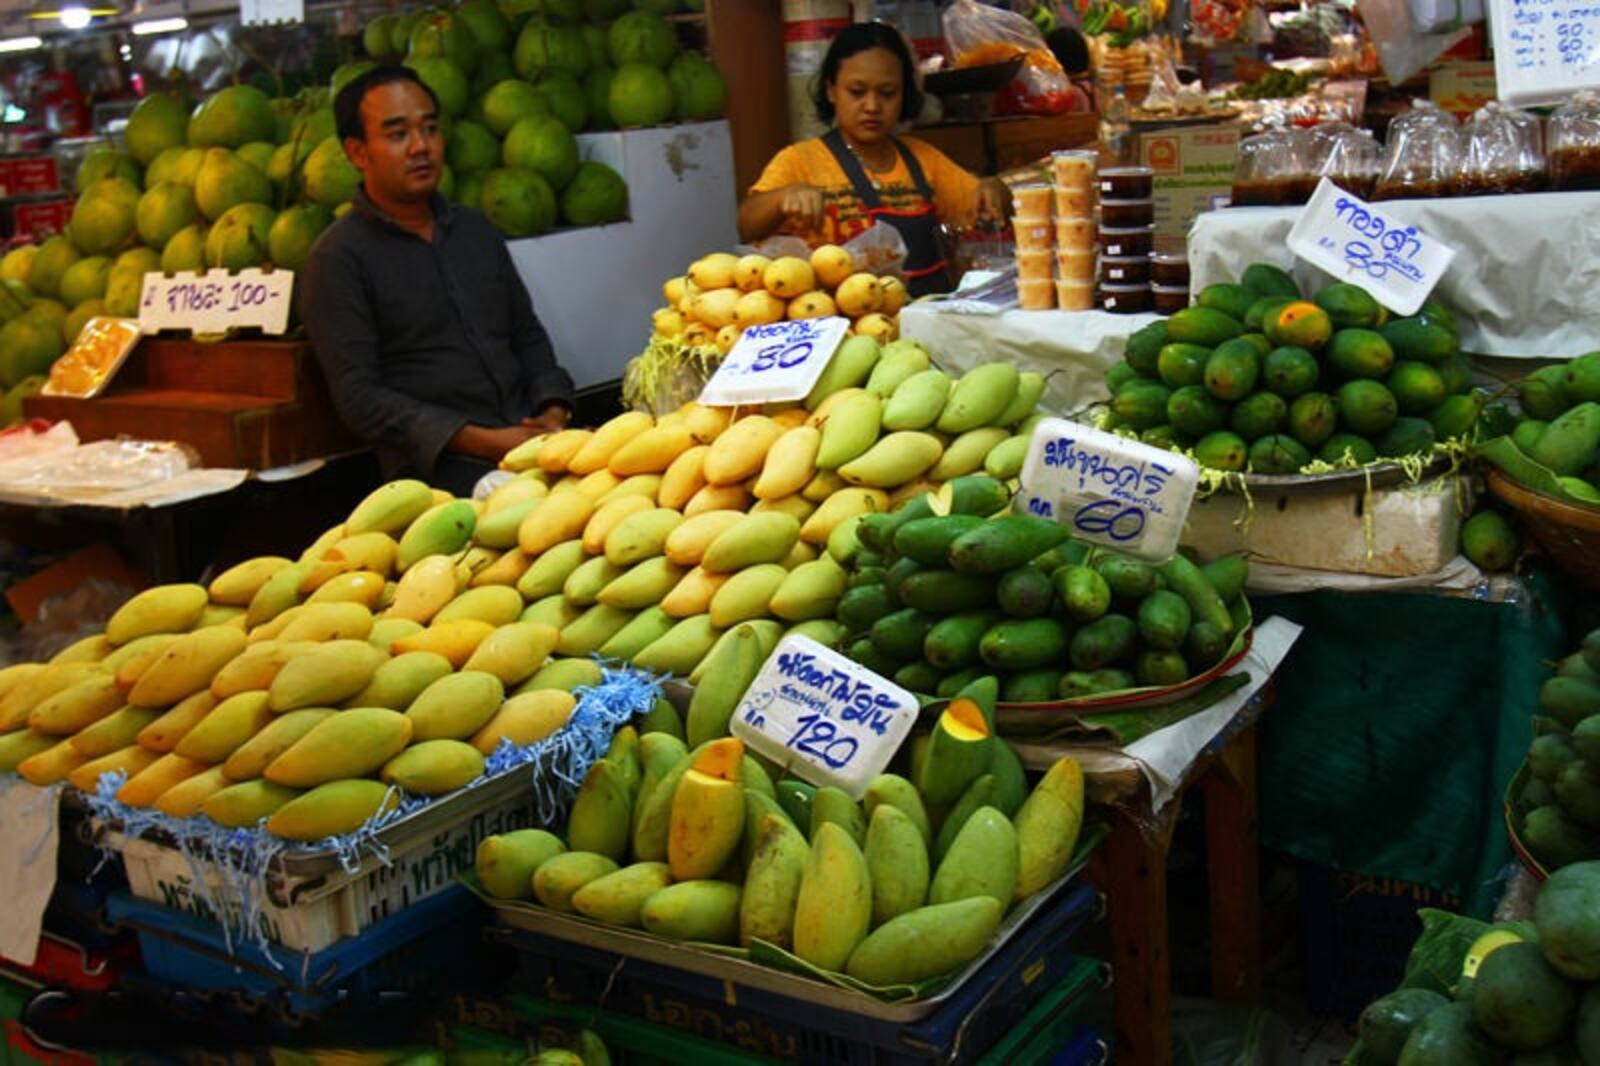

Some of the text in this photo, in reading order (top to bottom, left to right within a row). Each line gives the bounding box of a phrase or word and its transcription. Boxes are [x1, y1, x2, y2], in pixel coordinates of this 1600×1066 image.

[1335, 198, 1421, 258] ทองดำ
[1074, 500, 1145, 540] 60
[786, 714, 859, 769] 120
